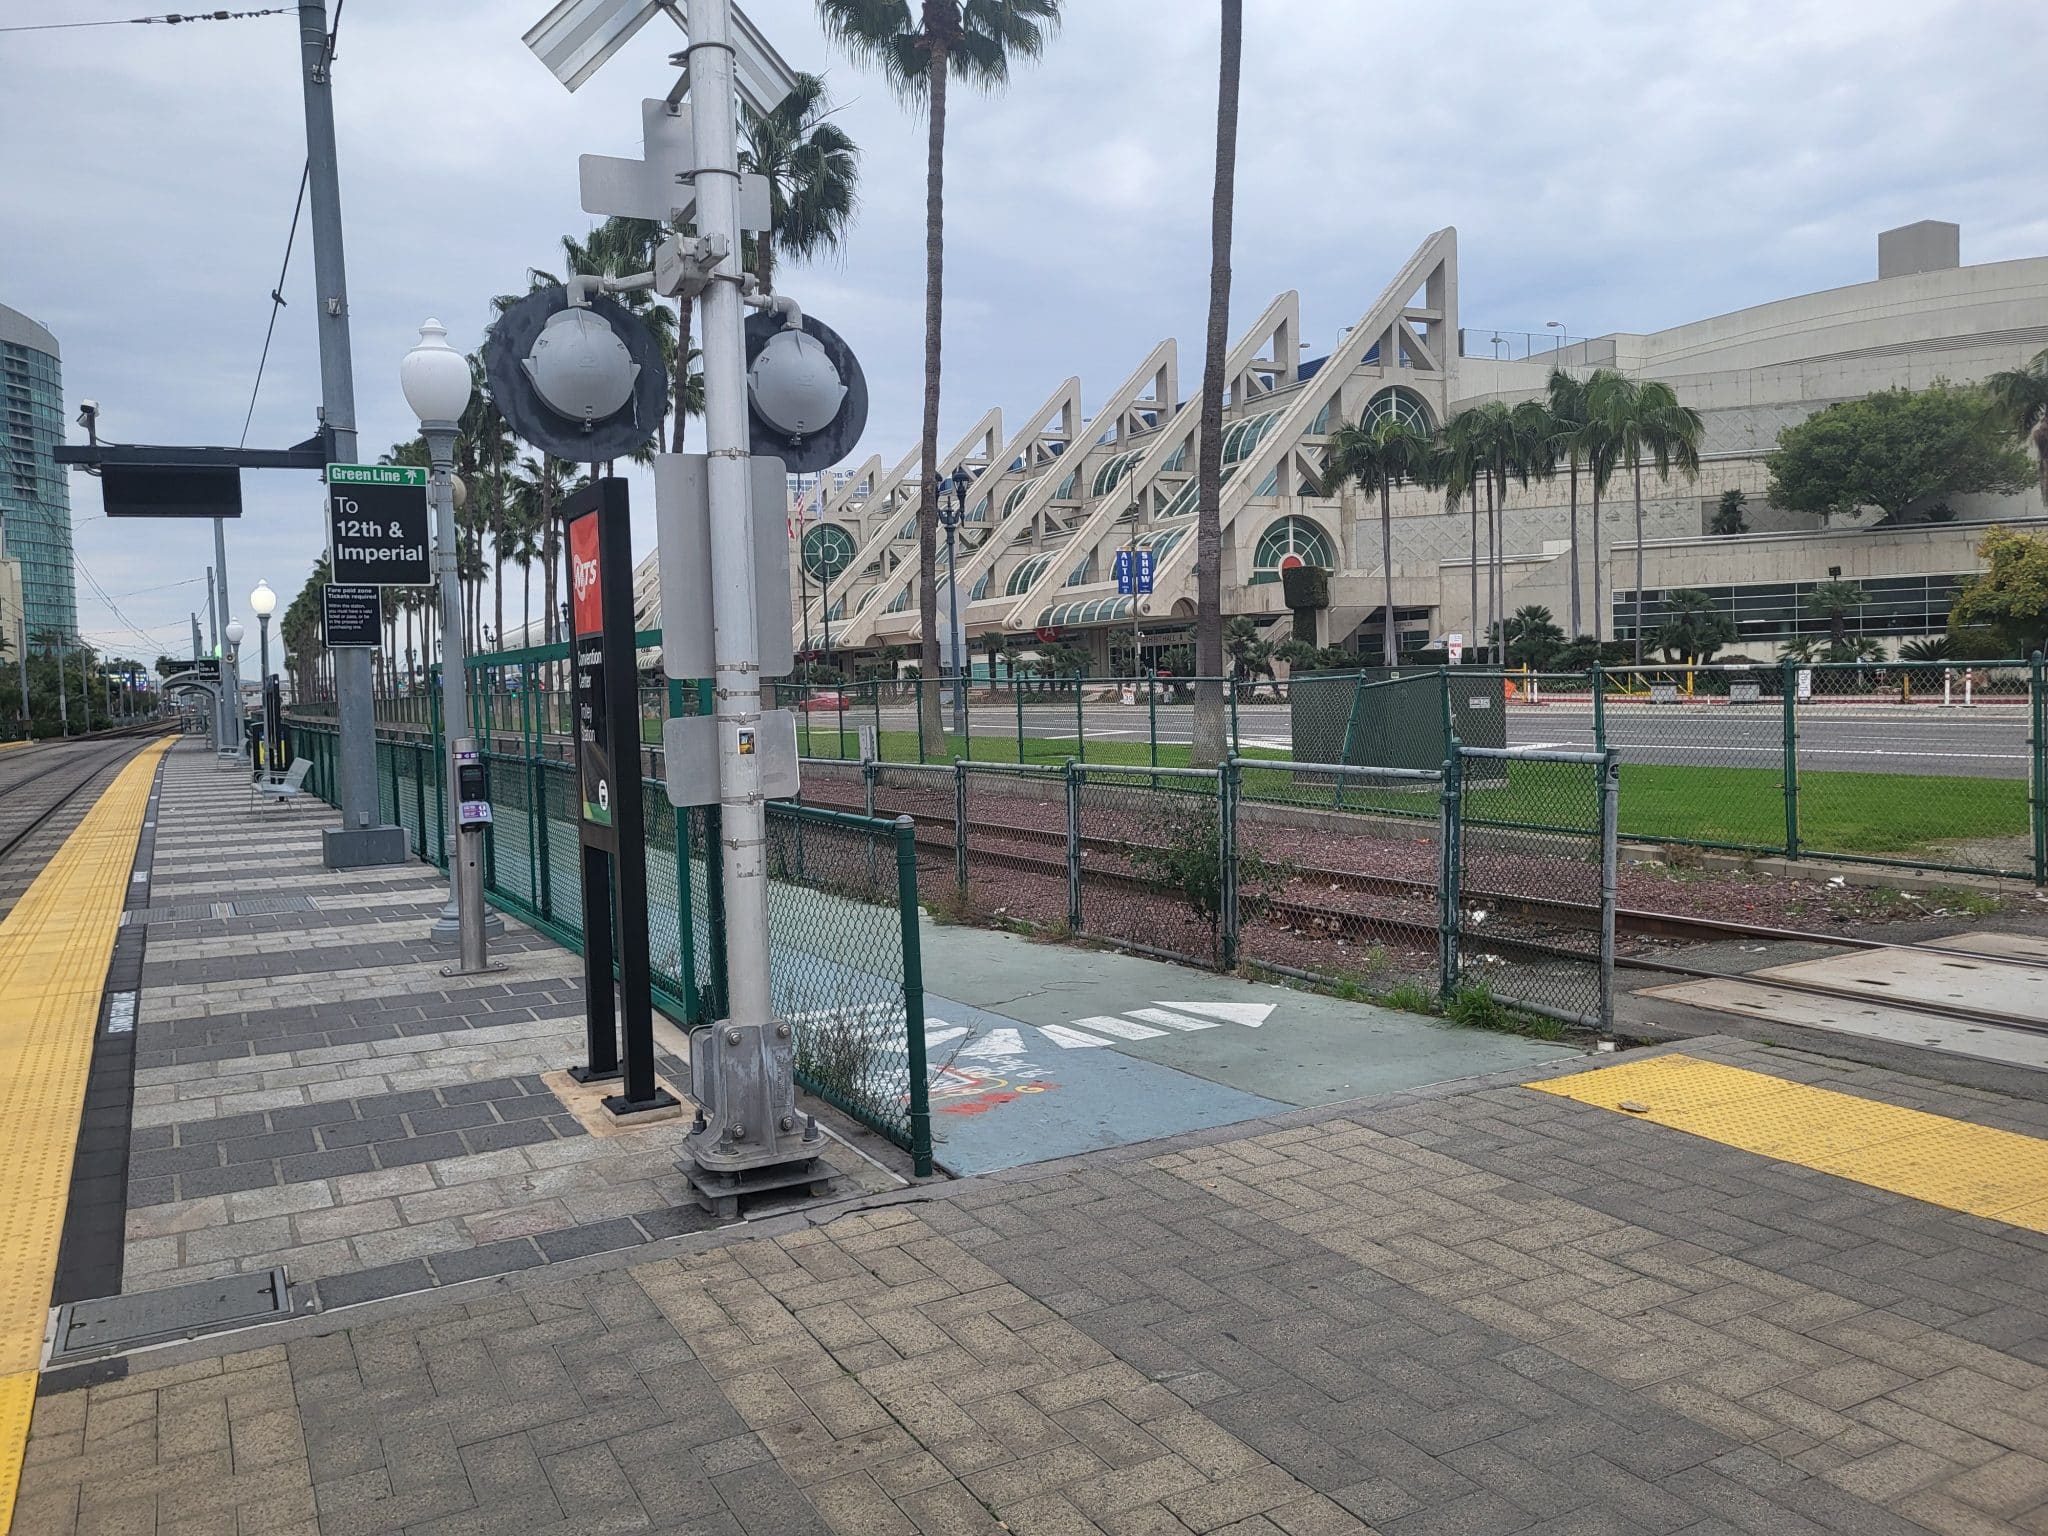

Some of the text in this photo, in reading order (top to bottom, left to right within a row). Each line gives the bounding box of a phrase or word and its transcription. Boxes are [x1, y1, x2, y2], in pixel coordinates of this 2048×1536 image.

[332, 467, 401, 482] Green Line
[334, 496, 359, 514] To
[337, 520, 404, 538] 12th &
[337, 543, 423, 564] Imperial
[574, 557, 597, 594] MTS
[1120, 552, 1129, 583] AUTO
[1141, 552, 1150, 583] SHOW
[578, 649, 602, 667] Convention
[578, 672, 592, 689] Center
[580, 702, 593, 724] Trolley
[580, 726, 596, 742] Station
